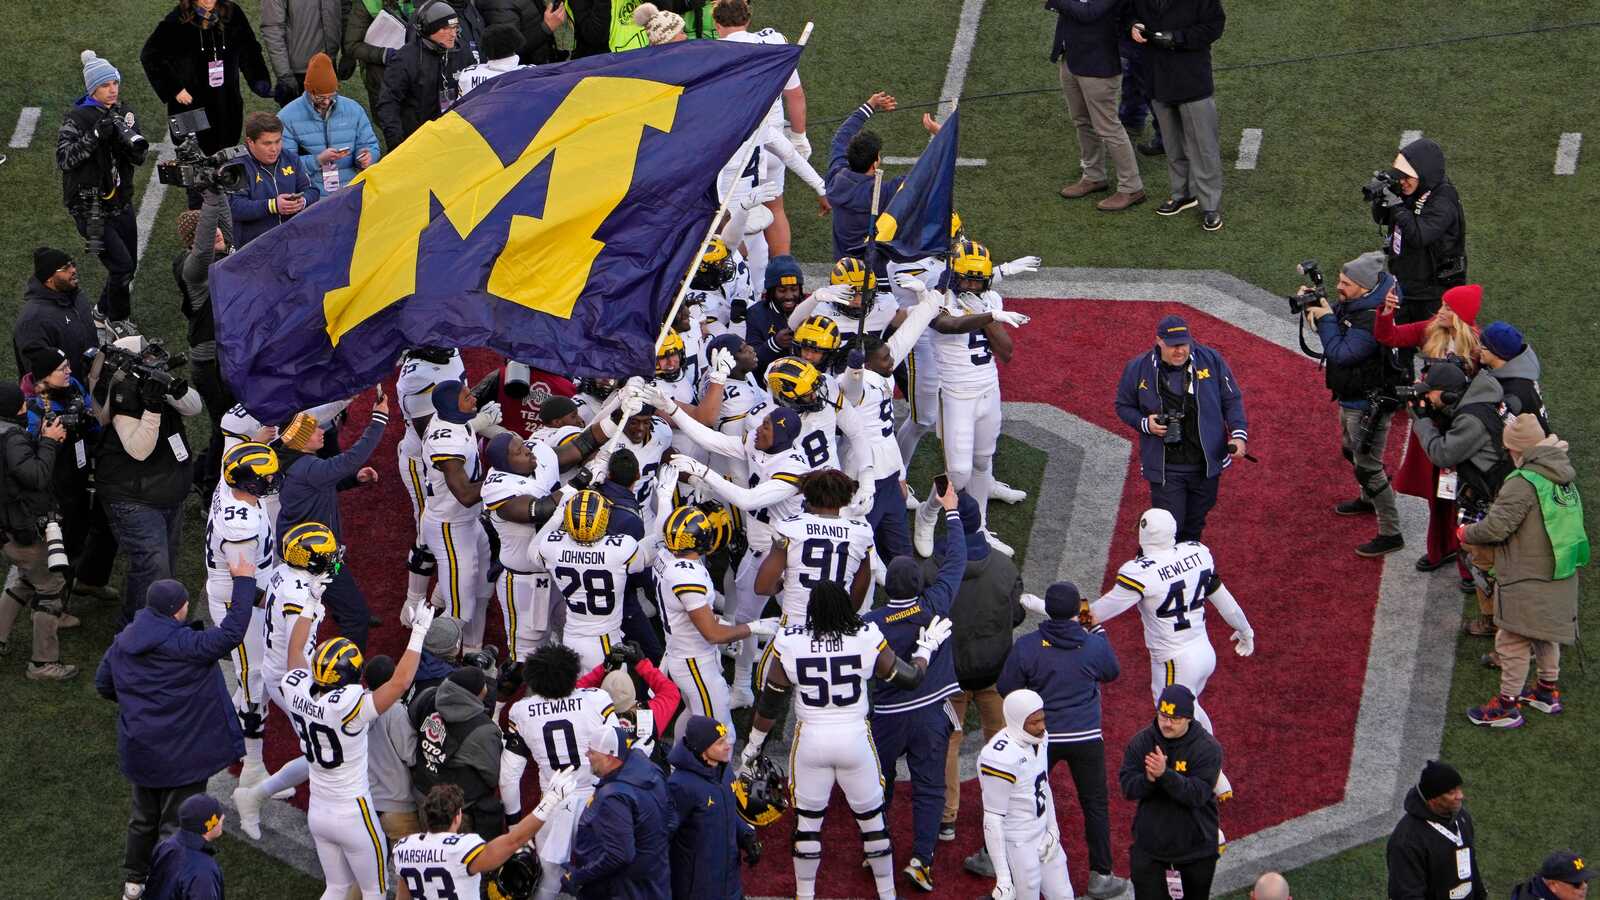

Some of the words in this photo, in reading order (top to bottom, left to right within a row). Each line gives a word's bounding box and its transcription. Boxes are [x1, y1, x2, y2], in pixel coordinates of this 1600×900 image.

[323, 77, 686, 349] M
[802, 430, 830, 468] 8
[224, 505, 248, 521] 54
[805, 523, 850, 539] BRANDT
[558, 549, 606, 565] JOHNSON
[798, 538, 850, 589] 91
[1157, 552, 1203, 582] HEWLETT
[536, 578, 549, 588] M
[554, 566, 616, 616] 28
[885, 604, 922, 624] MICHIGAN
[795, 654, 863, 708] 55
[292, 694, 326, 721] HANSEN
[528, 697, 583, 718] STEWART
[1160, 700, 1177, 716] M
[542, 718, 581, 772] 0
[992, 739, 1009, 752] 6
[1175, 760, 1188, 772] M
[397, 848, 448, 865] MARSHALL
